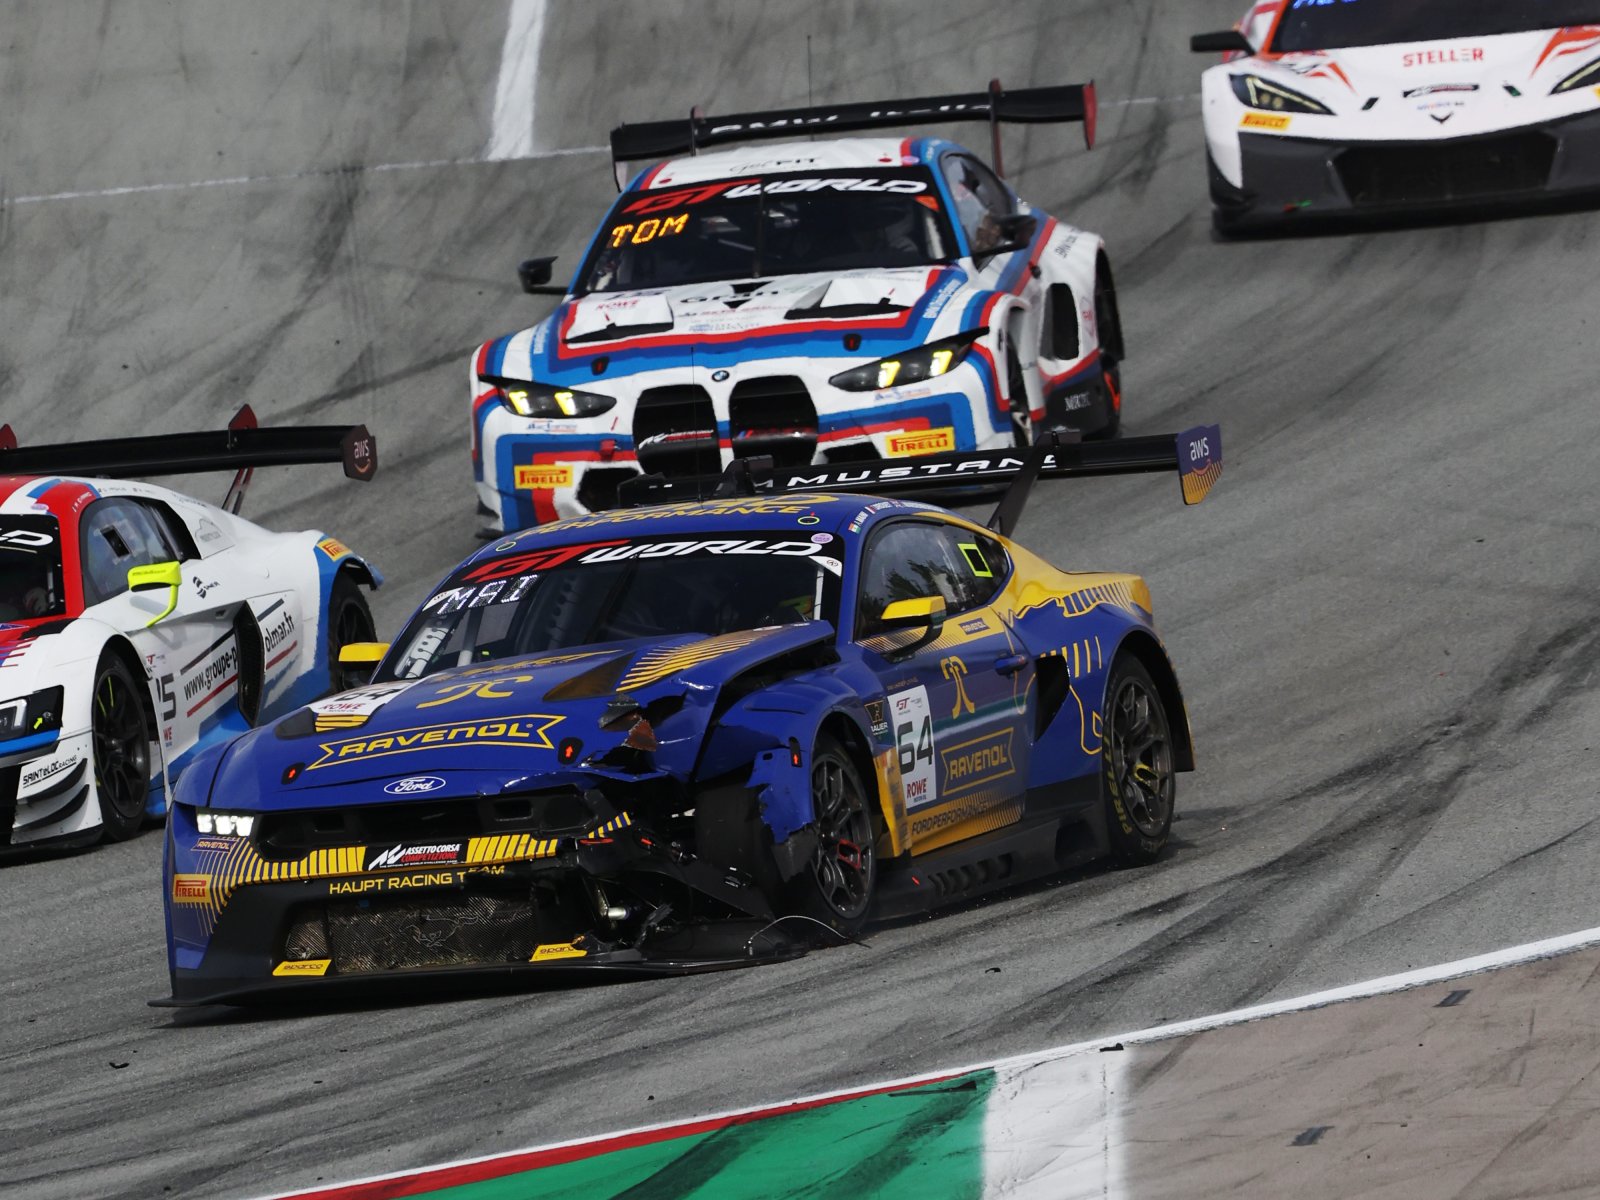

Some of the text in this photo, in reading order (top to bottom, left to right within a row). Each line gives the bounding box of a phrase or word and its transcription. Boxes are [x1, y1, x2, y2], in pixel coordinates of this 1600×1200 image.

[1403, 47, 1484, 68] STELLER
[722, 178, 928, 200] WORLD
[612, 213, 689, 247] TOM
[353, 438, 370, 459] aws
[891, 433, 949, 453] PIRELLI
[1190, 436, 1210, 462] aws
[519, 469, 570, 487] PIRELLI
[579, 540, 822, 568] WORLD
[338, 723, 532, 757] RAVENOL
[897, 715, 934, 776] 64
[949, 744, 1009, 781] RAVENOL
[394, 778, 435, 792] Ford
[906, 778, 928, 799] ROWE
[401, 852, 458, 863] COMPETIZIONE
[405, 843, 461, 855] ASSETTO CORSA
[175, 880, 207, 898] PIRELLI
[330, 878, 385, 895] HAUPT
[388, 872, 453, 890] RACING
[283, 962, 324, 971] sparco
